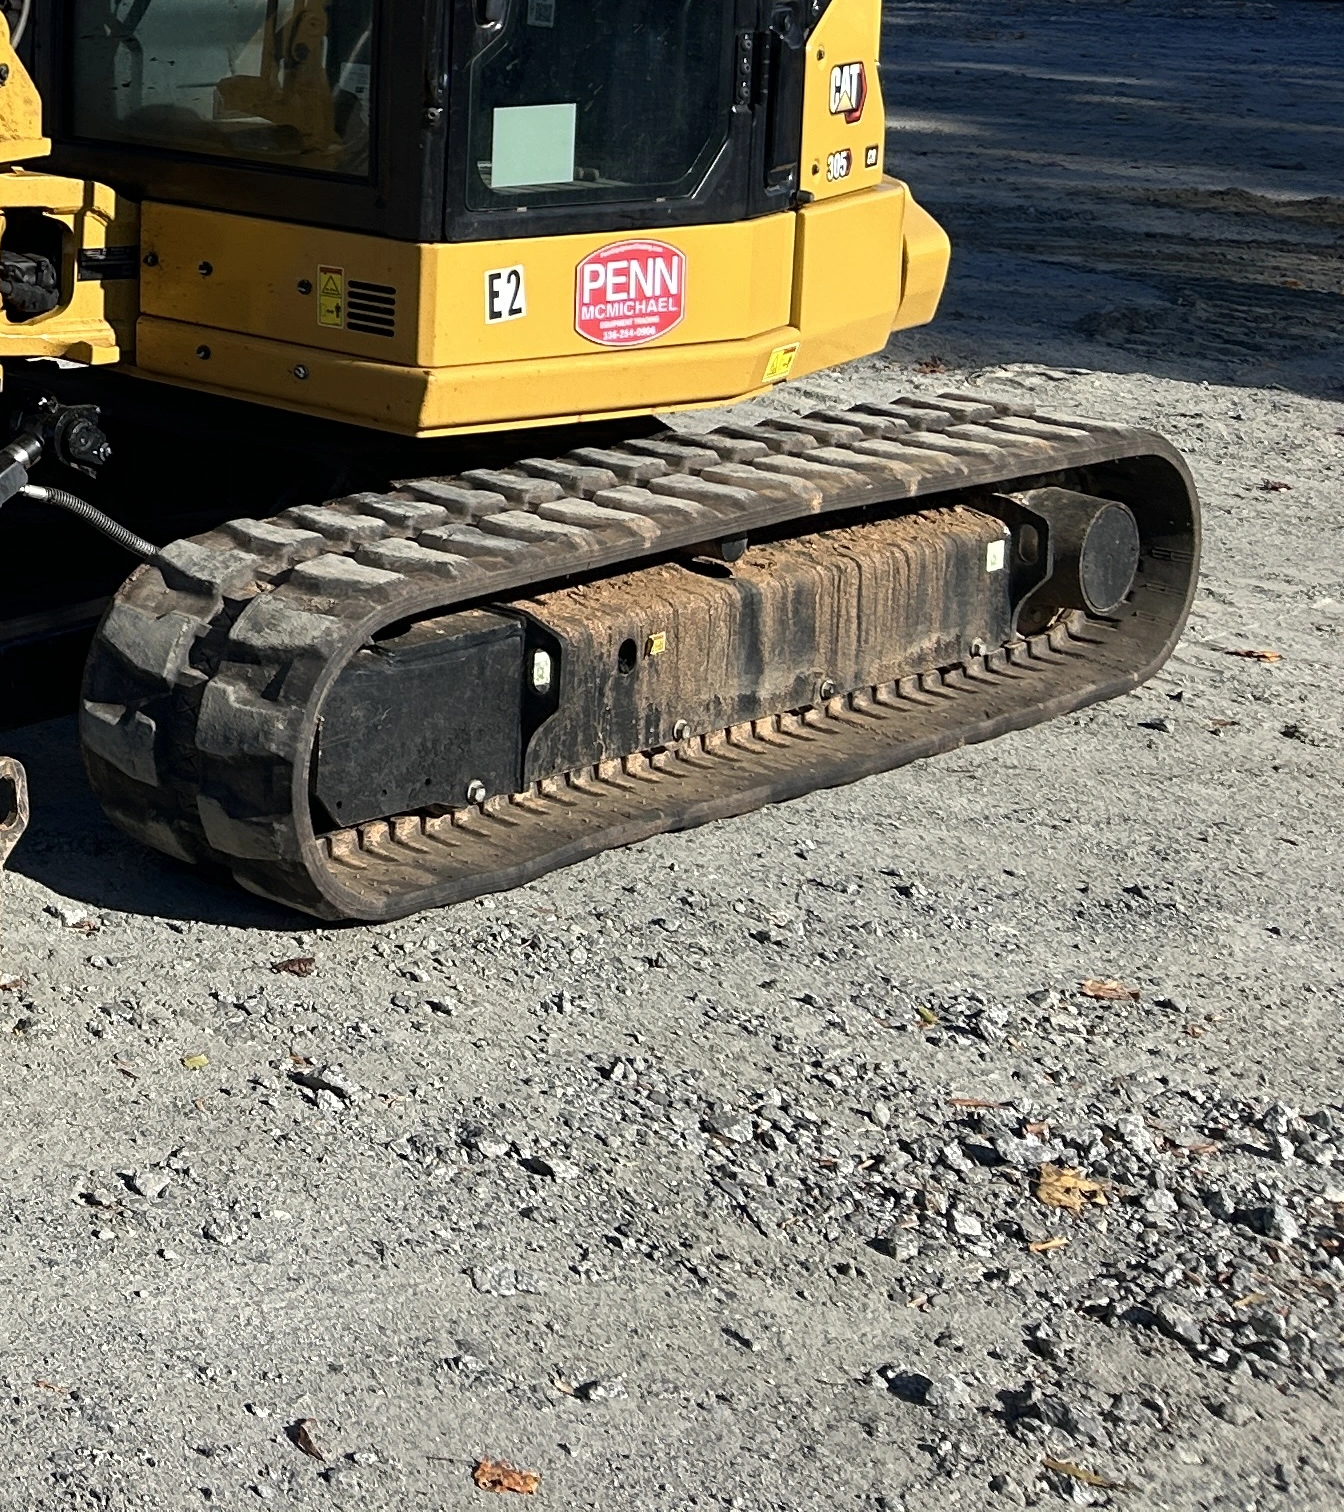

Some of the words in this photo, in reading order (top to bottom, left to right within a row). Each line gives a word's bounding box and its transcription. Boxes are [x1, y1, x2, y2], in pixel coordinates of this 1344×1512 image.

[828, 62, 862, 114] CAT
[825, 149, 850, 182] 305
[488, 269, 523, 320] E2
[582, 254, 679, 304] PENN
[581, 296, 679, 321] MCMICHAEL
